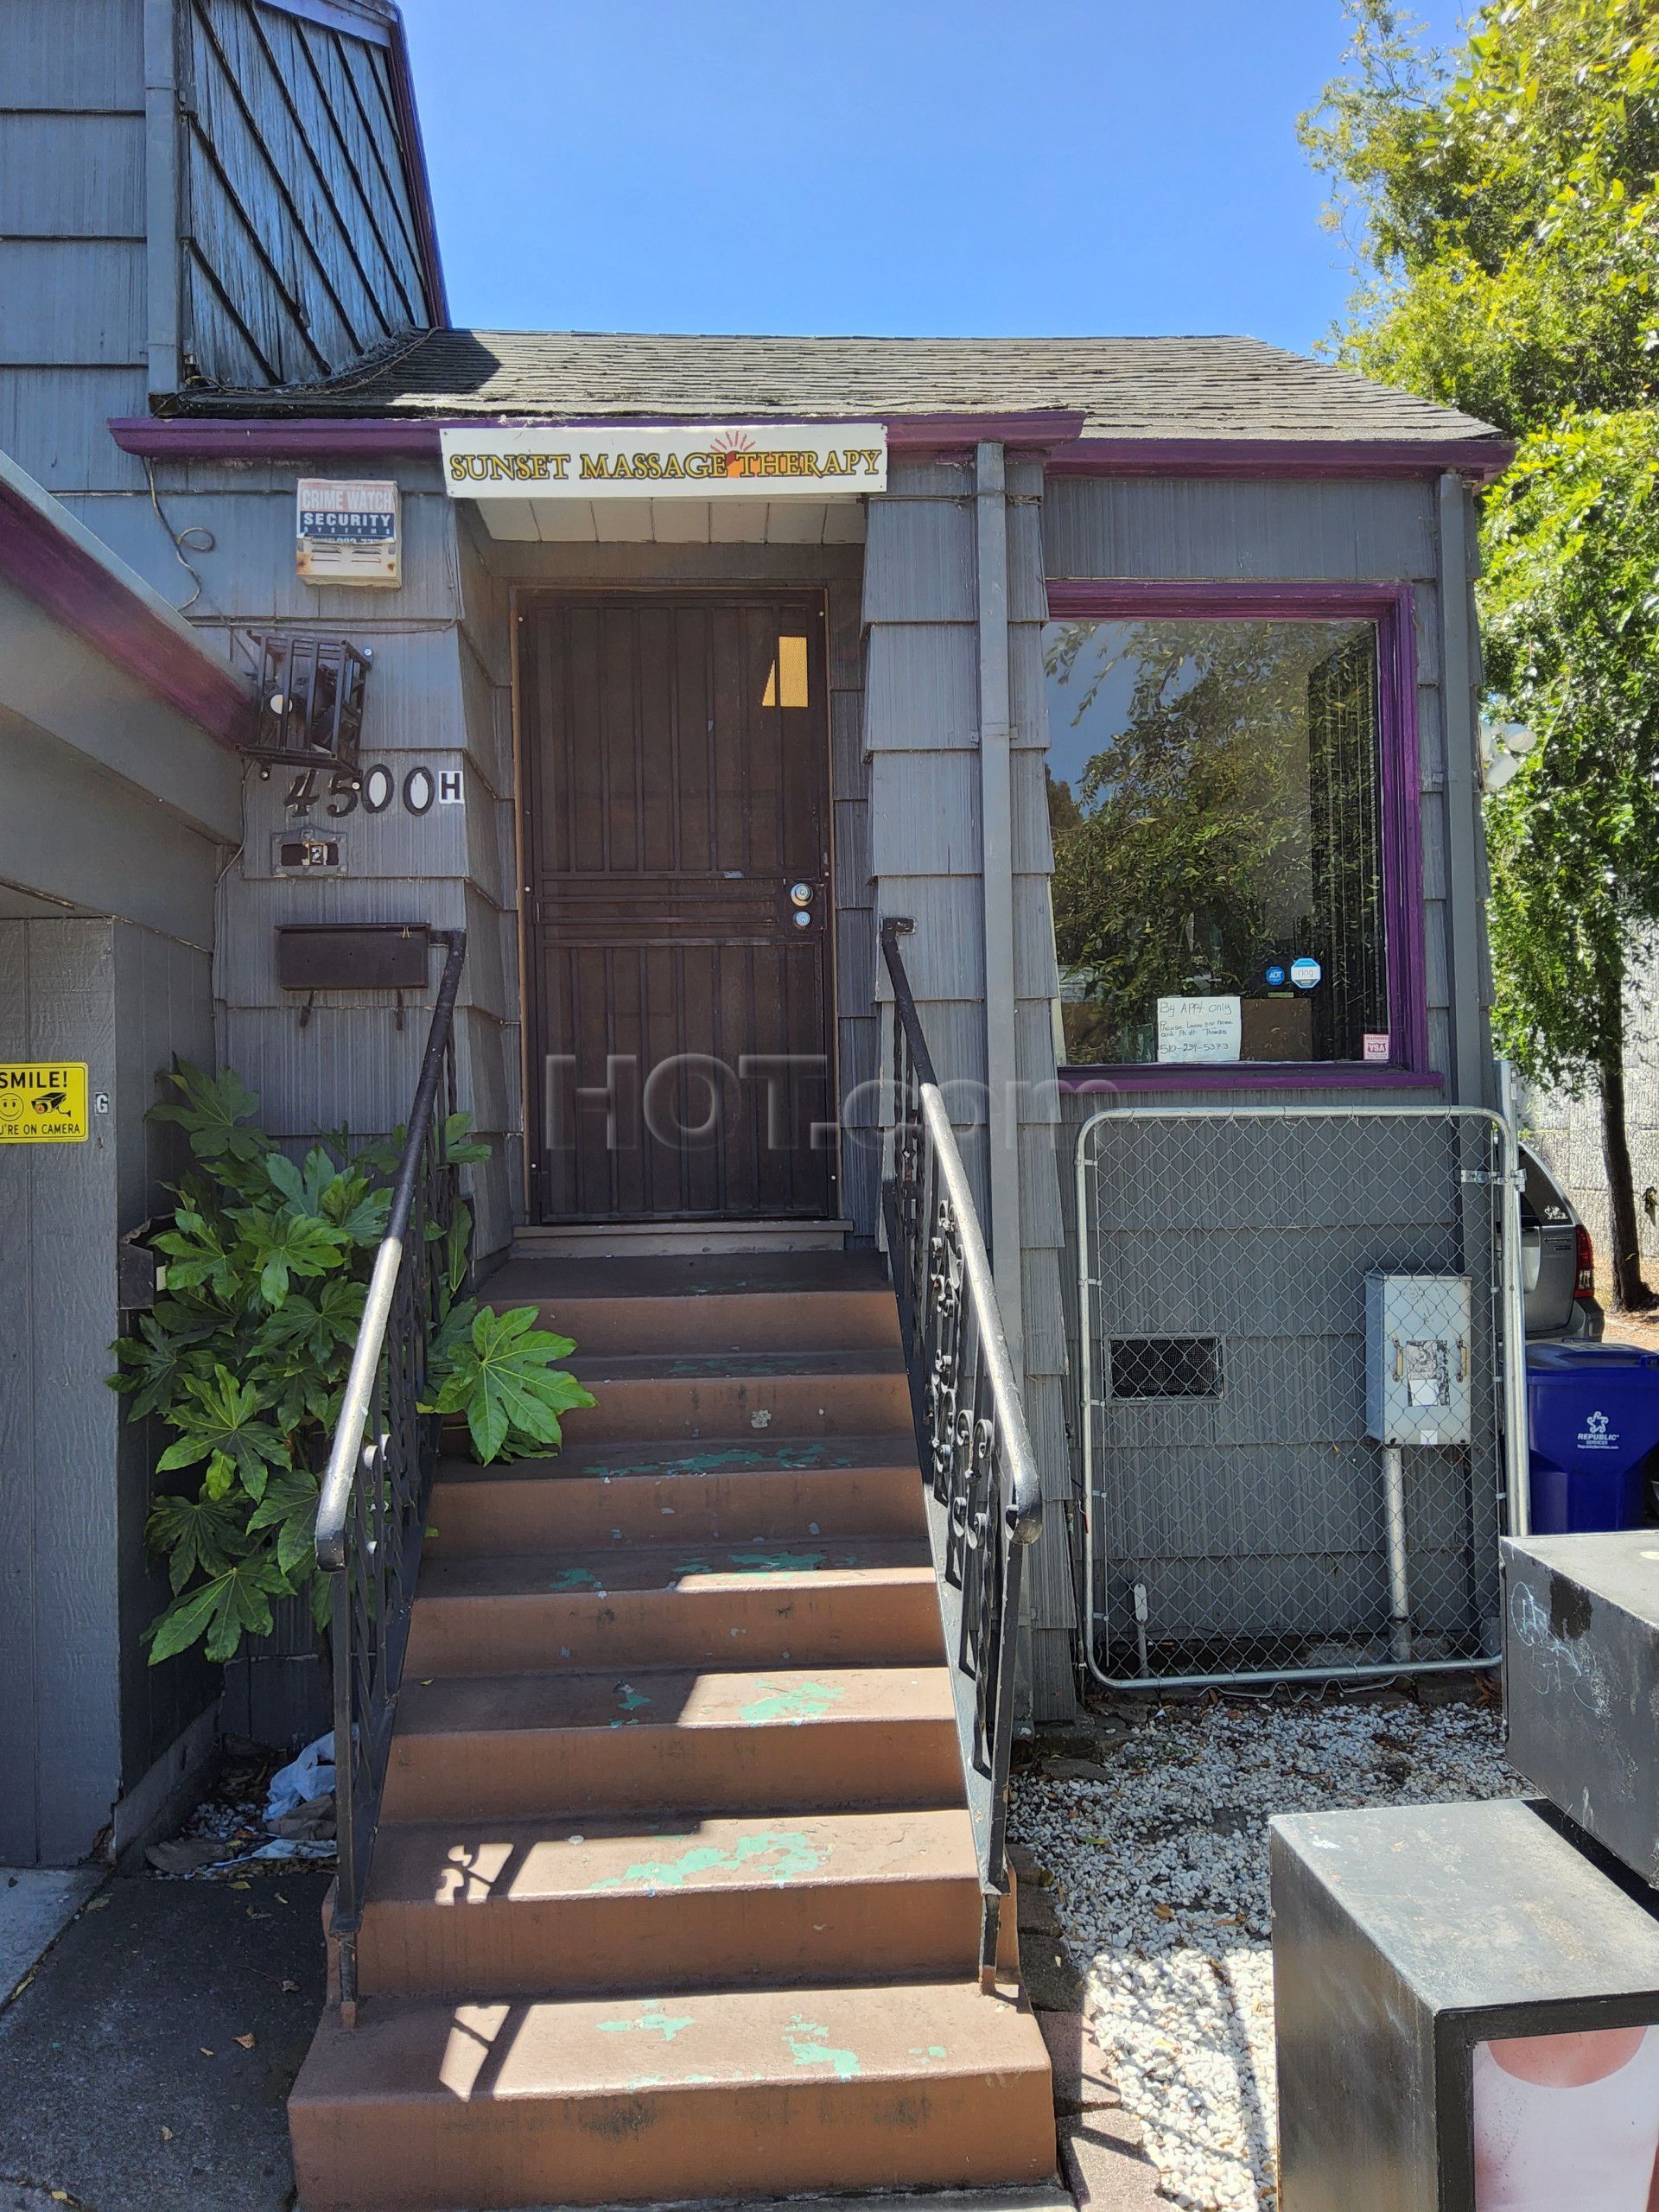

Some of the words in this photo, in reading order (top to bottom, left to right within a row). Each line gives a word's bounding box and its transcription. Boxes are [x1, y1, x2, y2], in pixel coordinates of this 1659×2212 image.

[450, 454, 569, 480] SUNSET
[580, 451, 728, 480] MASSAGE
[736, 448, 882, 478] THERAPY
[302, 489, 343, 510] CRIME
[347, 490, 392, 511] WATCH
[303, 512, 391, 527] SECURITY
[1298, 969, 1314, 978] ring
[1160, 1001, 1175, 1017] By
[1208, 1002, 1231, 1014] only
[96, 1094, 109, 1114] G
[23, 1124, 37, 1135] ON
[41, 1123, 80, 1134] CAMERA
